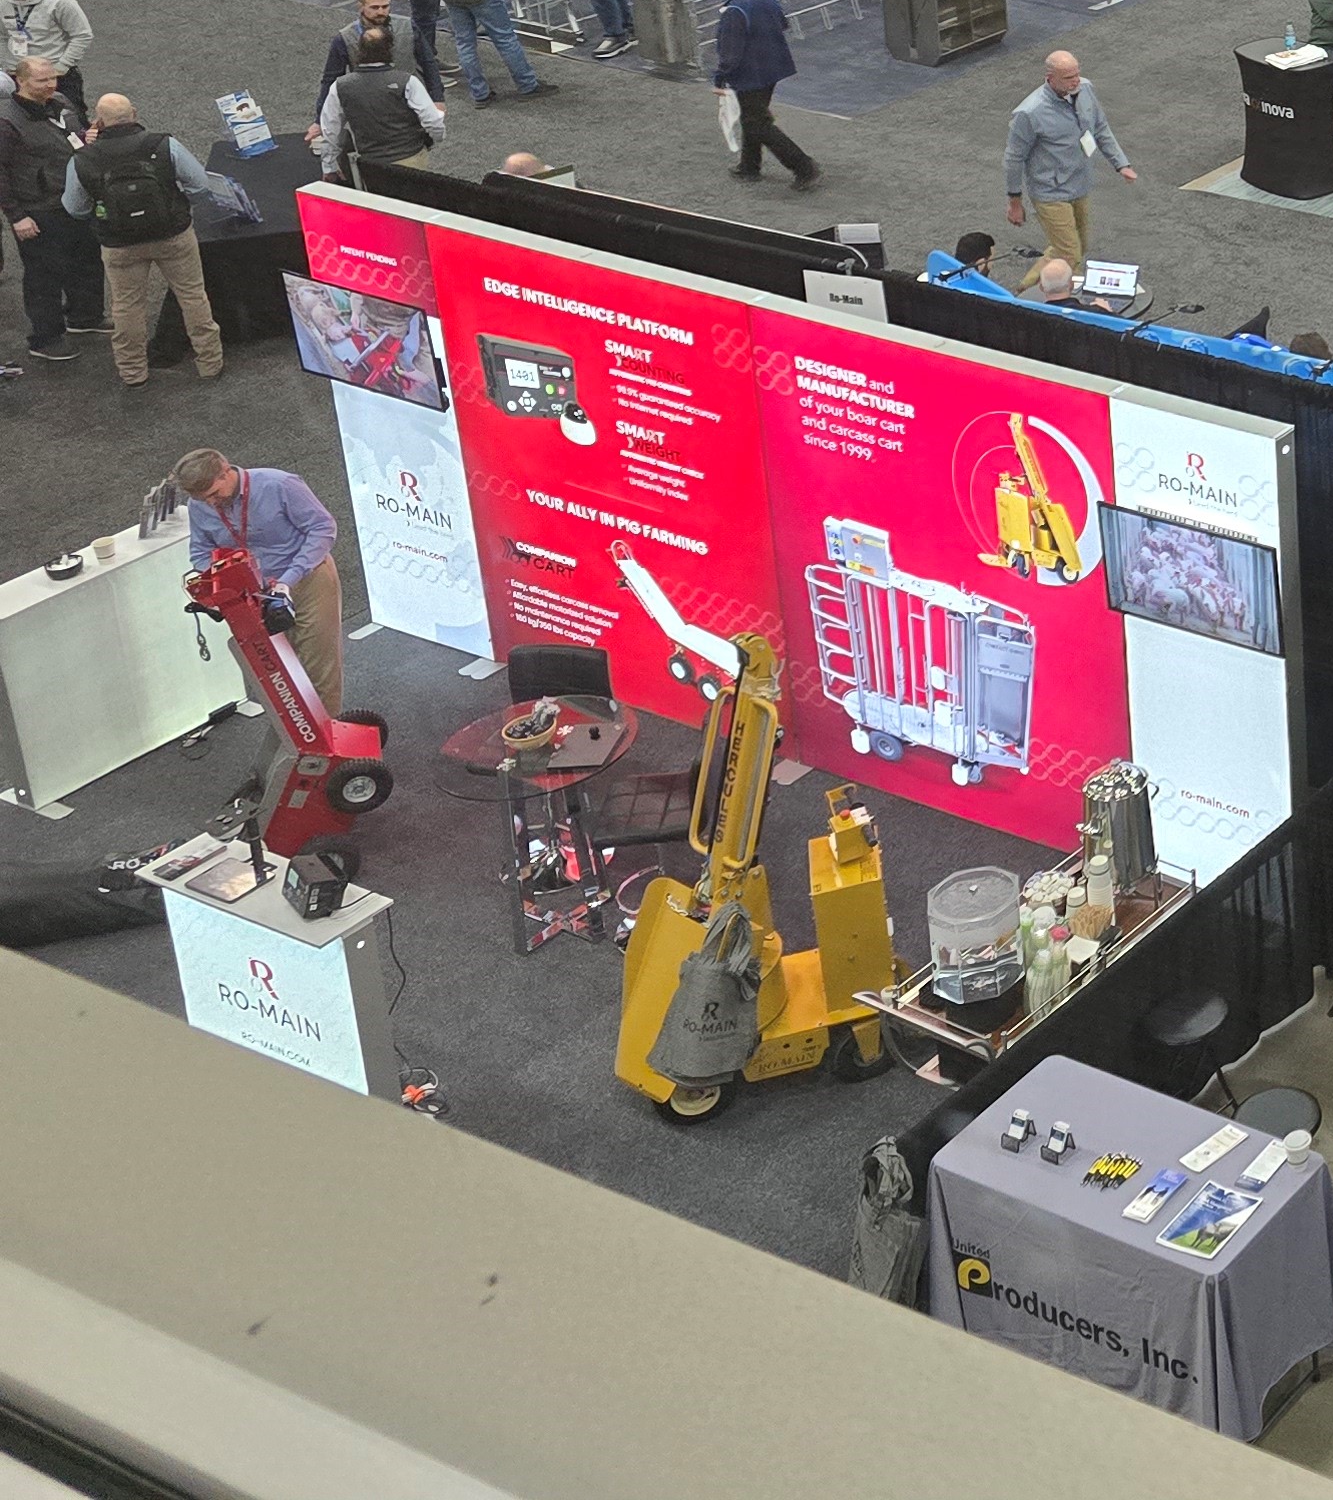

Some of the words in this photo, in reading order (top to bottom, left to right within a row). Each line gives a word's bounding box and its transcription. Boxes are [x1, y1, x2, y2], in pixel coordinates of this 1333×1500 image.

[484, 277, 519, 298] EDGE
[522, 288, 615, 324] INTELLIGENCE
[617, 309, 694, 346] PLATFORM
[829, 291, 864, 306] Ro-Main
[794, 356, 867, 387] DESIGNER
[869, 378, 895, 395] and
[796, 375, 914, 419] MANUFACTURER
[376, 494, 453, 531] RO-MAIN
[218, 984, 321, 1041] RO-MAIN
